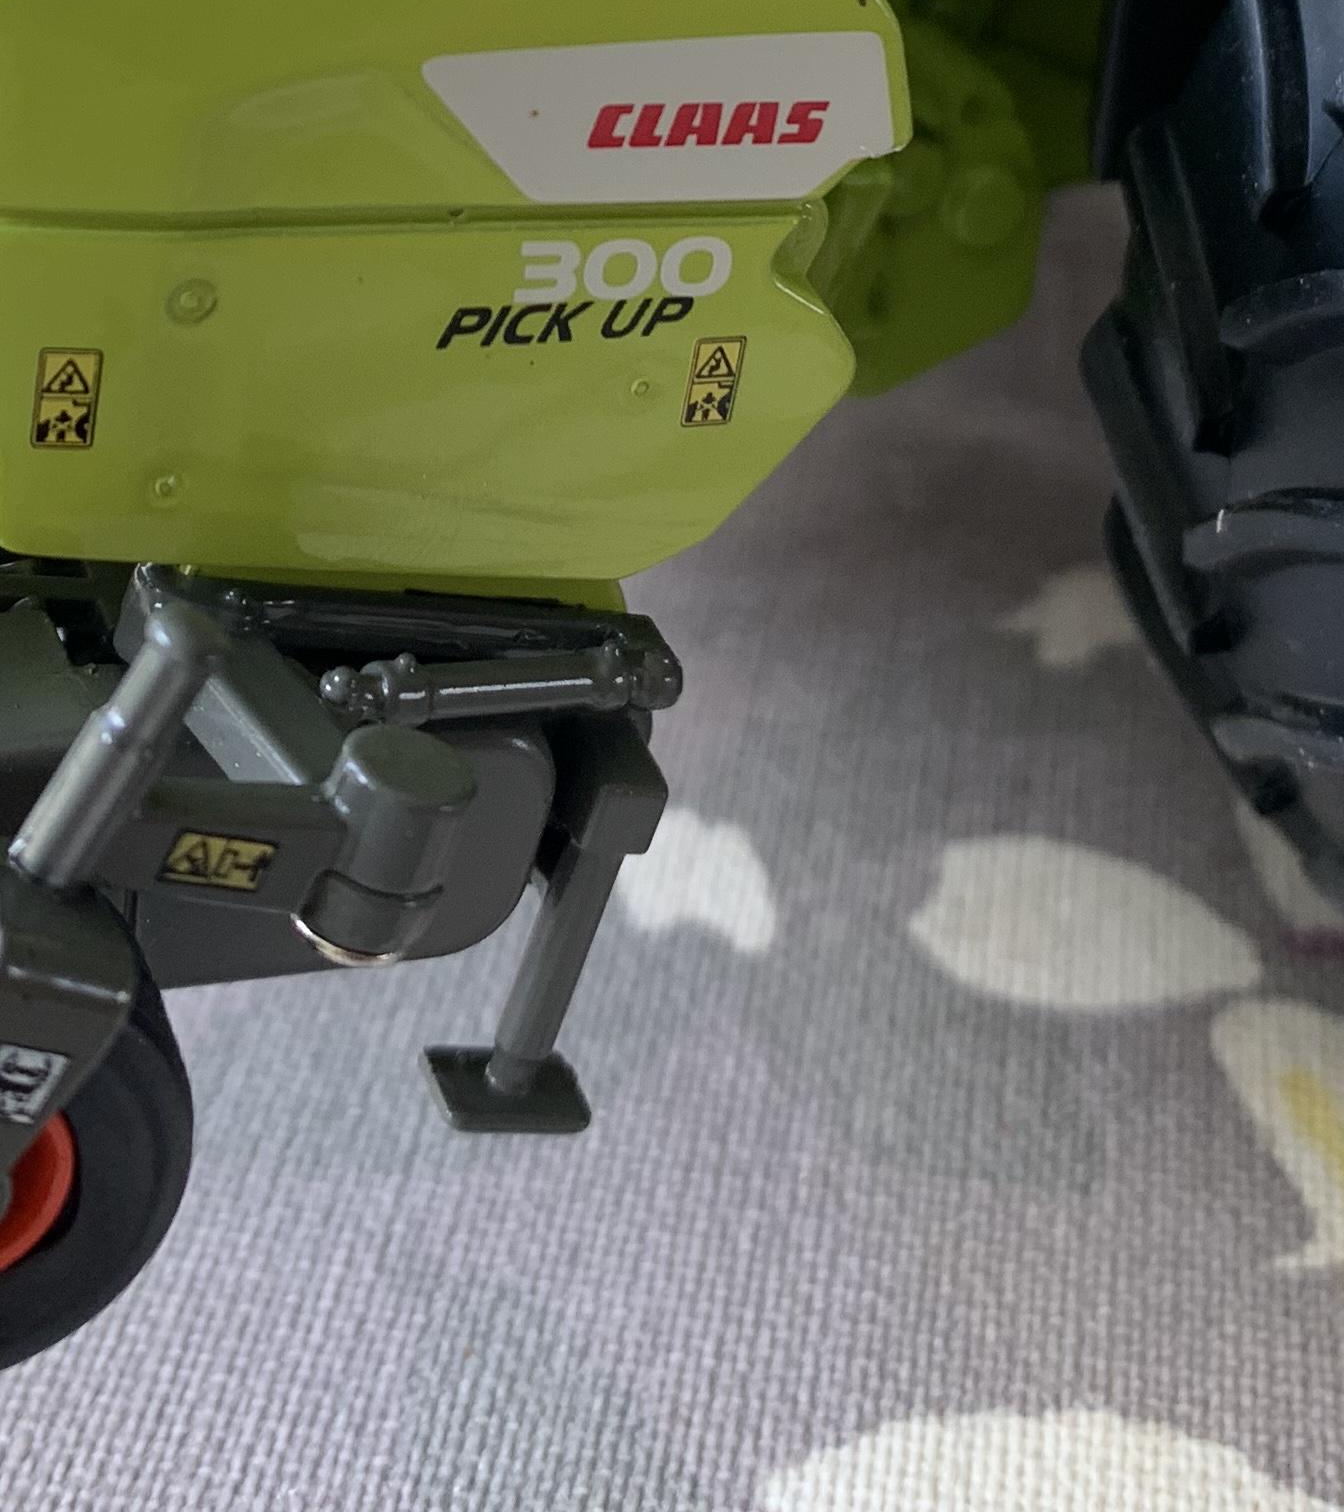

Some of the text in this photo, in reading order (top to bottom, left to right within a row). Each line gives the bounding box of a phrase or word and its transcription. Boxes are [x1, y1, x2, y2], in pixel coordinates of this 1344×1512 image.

[587, 100, 830, 149] CLAAS
[513, 235, 733, 305] 300
[436, 296, 694, 350] PICK UP
